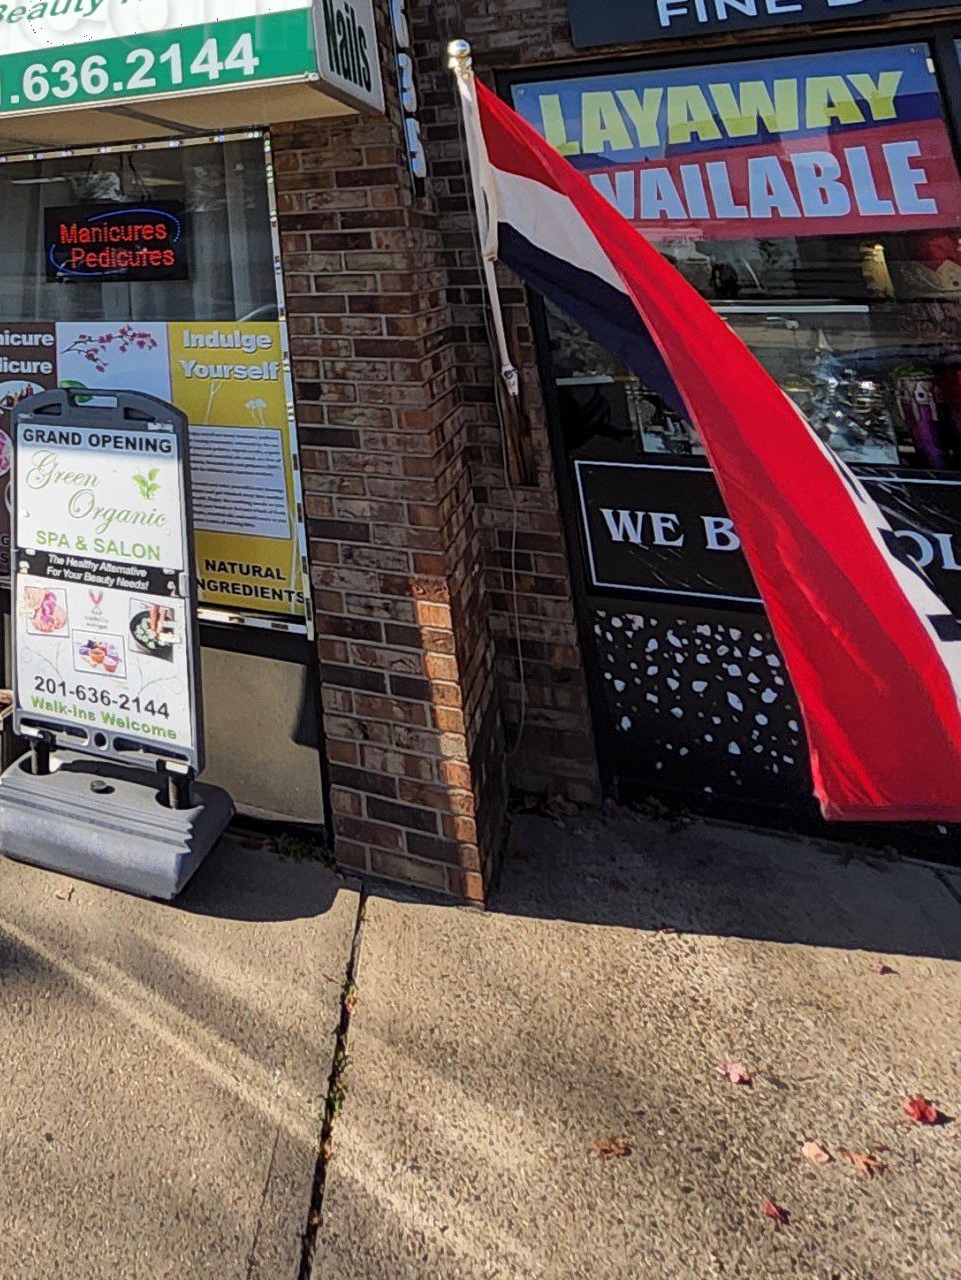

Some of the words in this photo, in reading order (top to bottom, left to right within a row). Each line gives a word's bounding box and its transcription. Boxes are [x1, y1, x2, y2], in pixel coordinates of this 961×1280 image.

[539, 71, 904, 157] LAYAWAY
[589, 140, 939, 220] VAILABLE
[59, 222, 168, 244] Manicures
[70, 246, 175, 269] Pedicures
[183, 330, 273, 354] Indulge
[179, 360, 281, 380] Yourself
[23, 428, 82, 446] GRAND
[88, 433, 172, 454] OPENING
[26, 450, 99, 489] Green
[68, 488, 167, 535] Organic
[599, 508, 685, 548] WE
[36, 530, 70, 548] SPA
[75, 535, 88, 552] &
[94, 538, 161, 561] SALON
[46, 566, 61, 577] For
[63, 568, 83, 580] Your
[84, 572, 116, 587] Beauty
[48, 554, 64, 565] The
[65, 556, 98, 572] Healthy
[99, 563, 147, 577] Alternative
[204, 559, 287, 581] NATURAL
[196, 578, 305, 604] NGREDIENTS
[34, 675, 169, 719] 201-636-2144
[100, 710, 177, 740] Welcome
